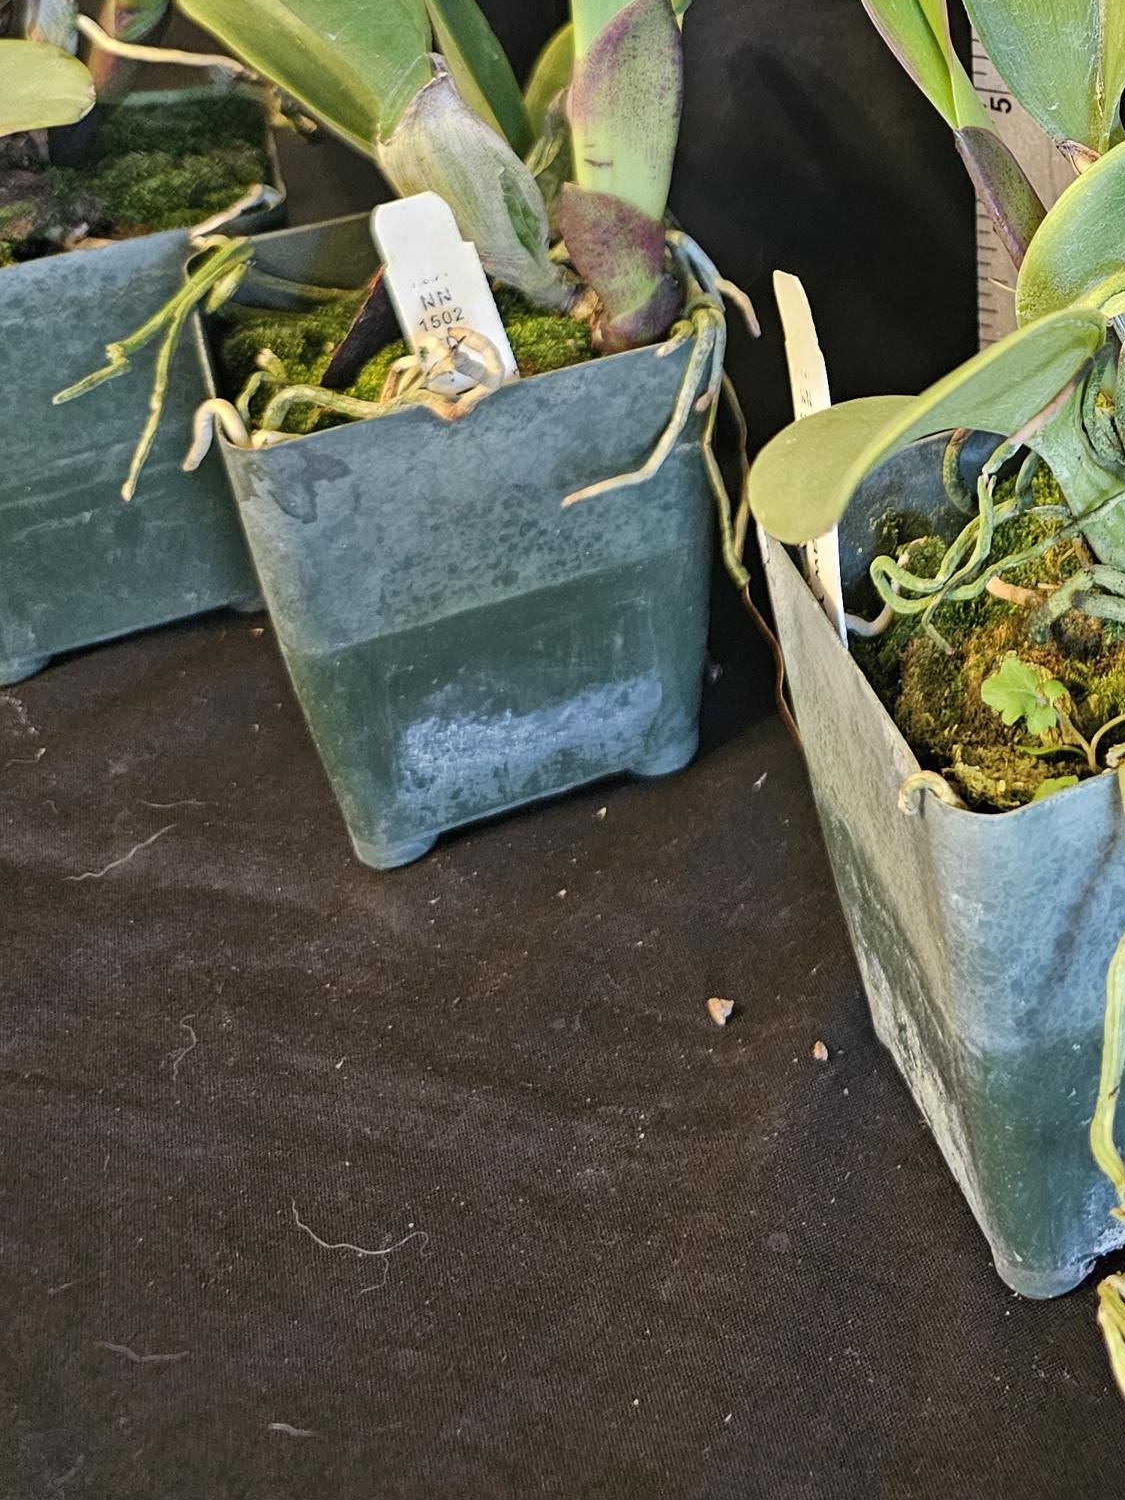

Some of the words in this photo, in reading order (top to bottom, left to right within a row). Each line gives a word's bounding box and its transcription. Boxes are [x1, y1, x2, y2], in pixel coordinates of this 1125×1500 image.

[990, 97, 1012, 115] 5
[419, 287, 453, 312] NN
[418, 306, 465, 332] 1502
